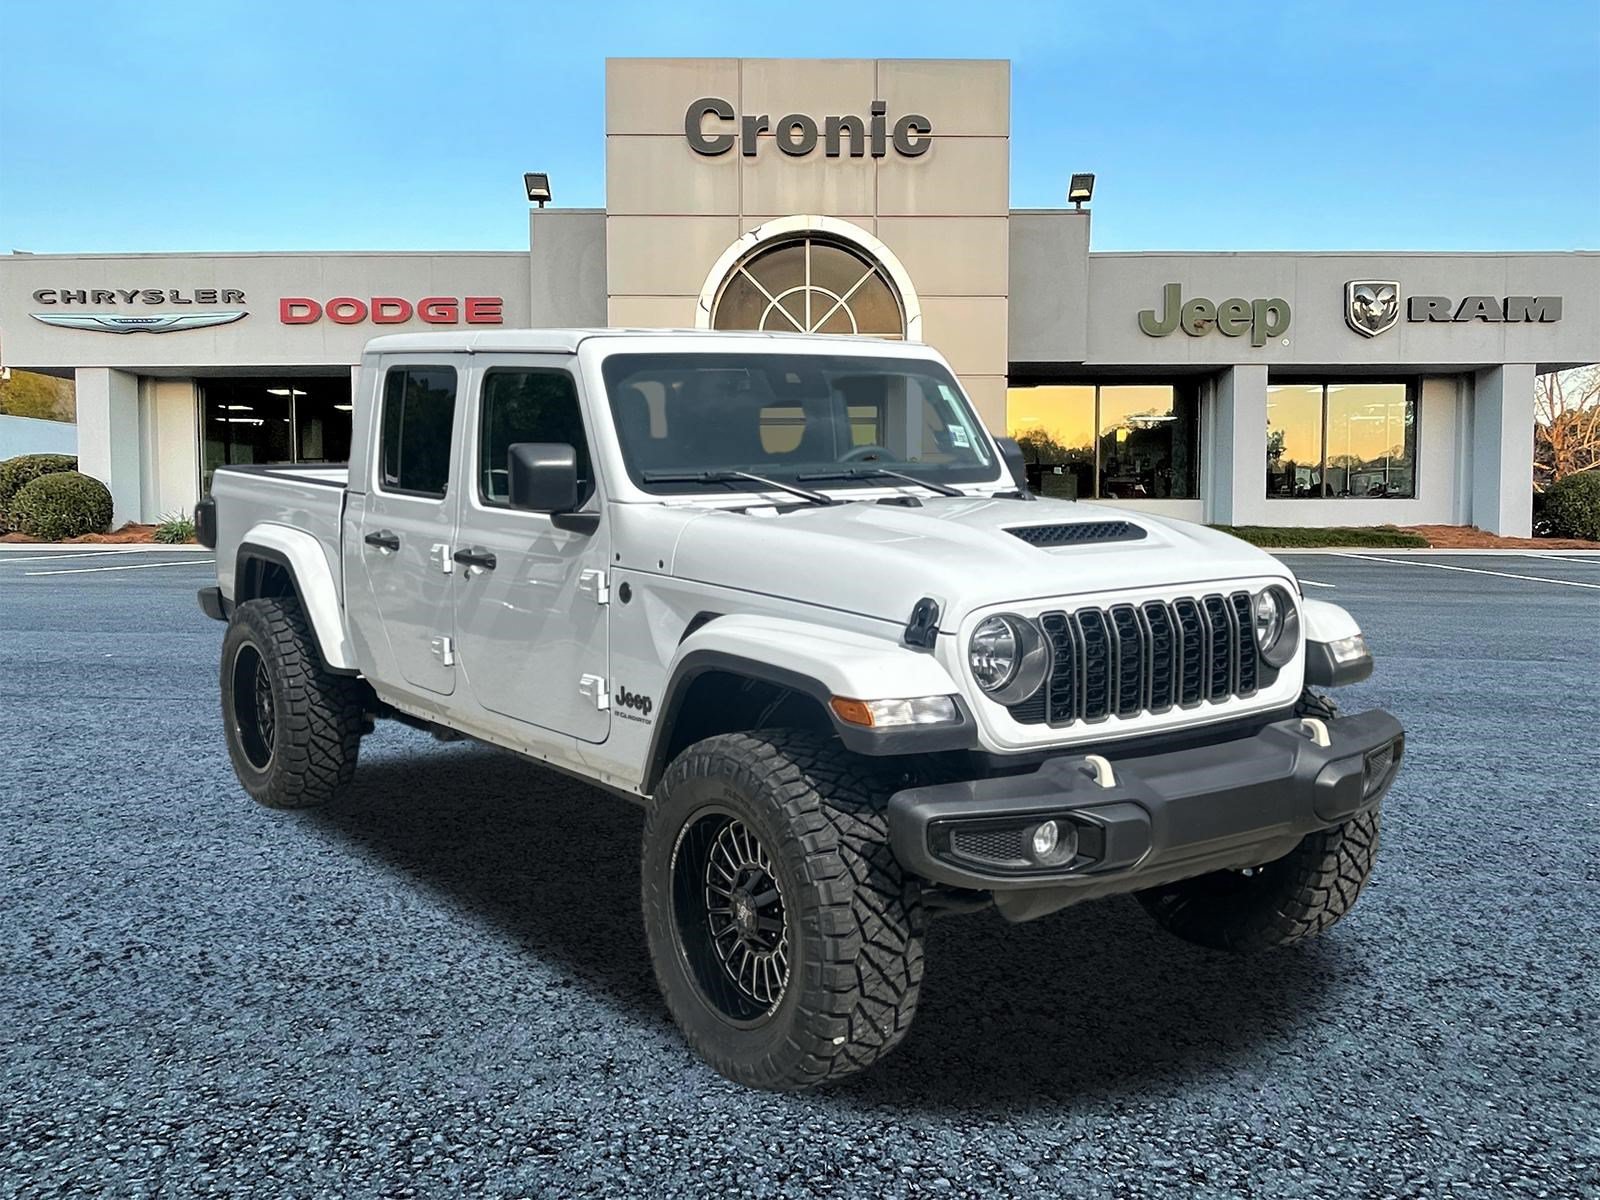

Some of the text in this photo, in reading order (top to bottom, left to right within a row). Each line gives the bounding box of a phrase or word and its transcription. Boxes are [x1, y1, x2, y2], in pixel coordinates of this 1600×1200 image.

[685, 97, 933, 158] Cronic
[32, 288, 248, 305] CHRYSLER
[279, 296, 504, 325] DODGE
[1407, 296, 1563, 323] RAM
[1138, 283, 1292, 348] Jeep
[615, 685, 653, 716] Jeep
